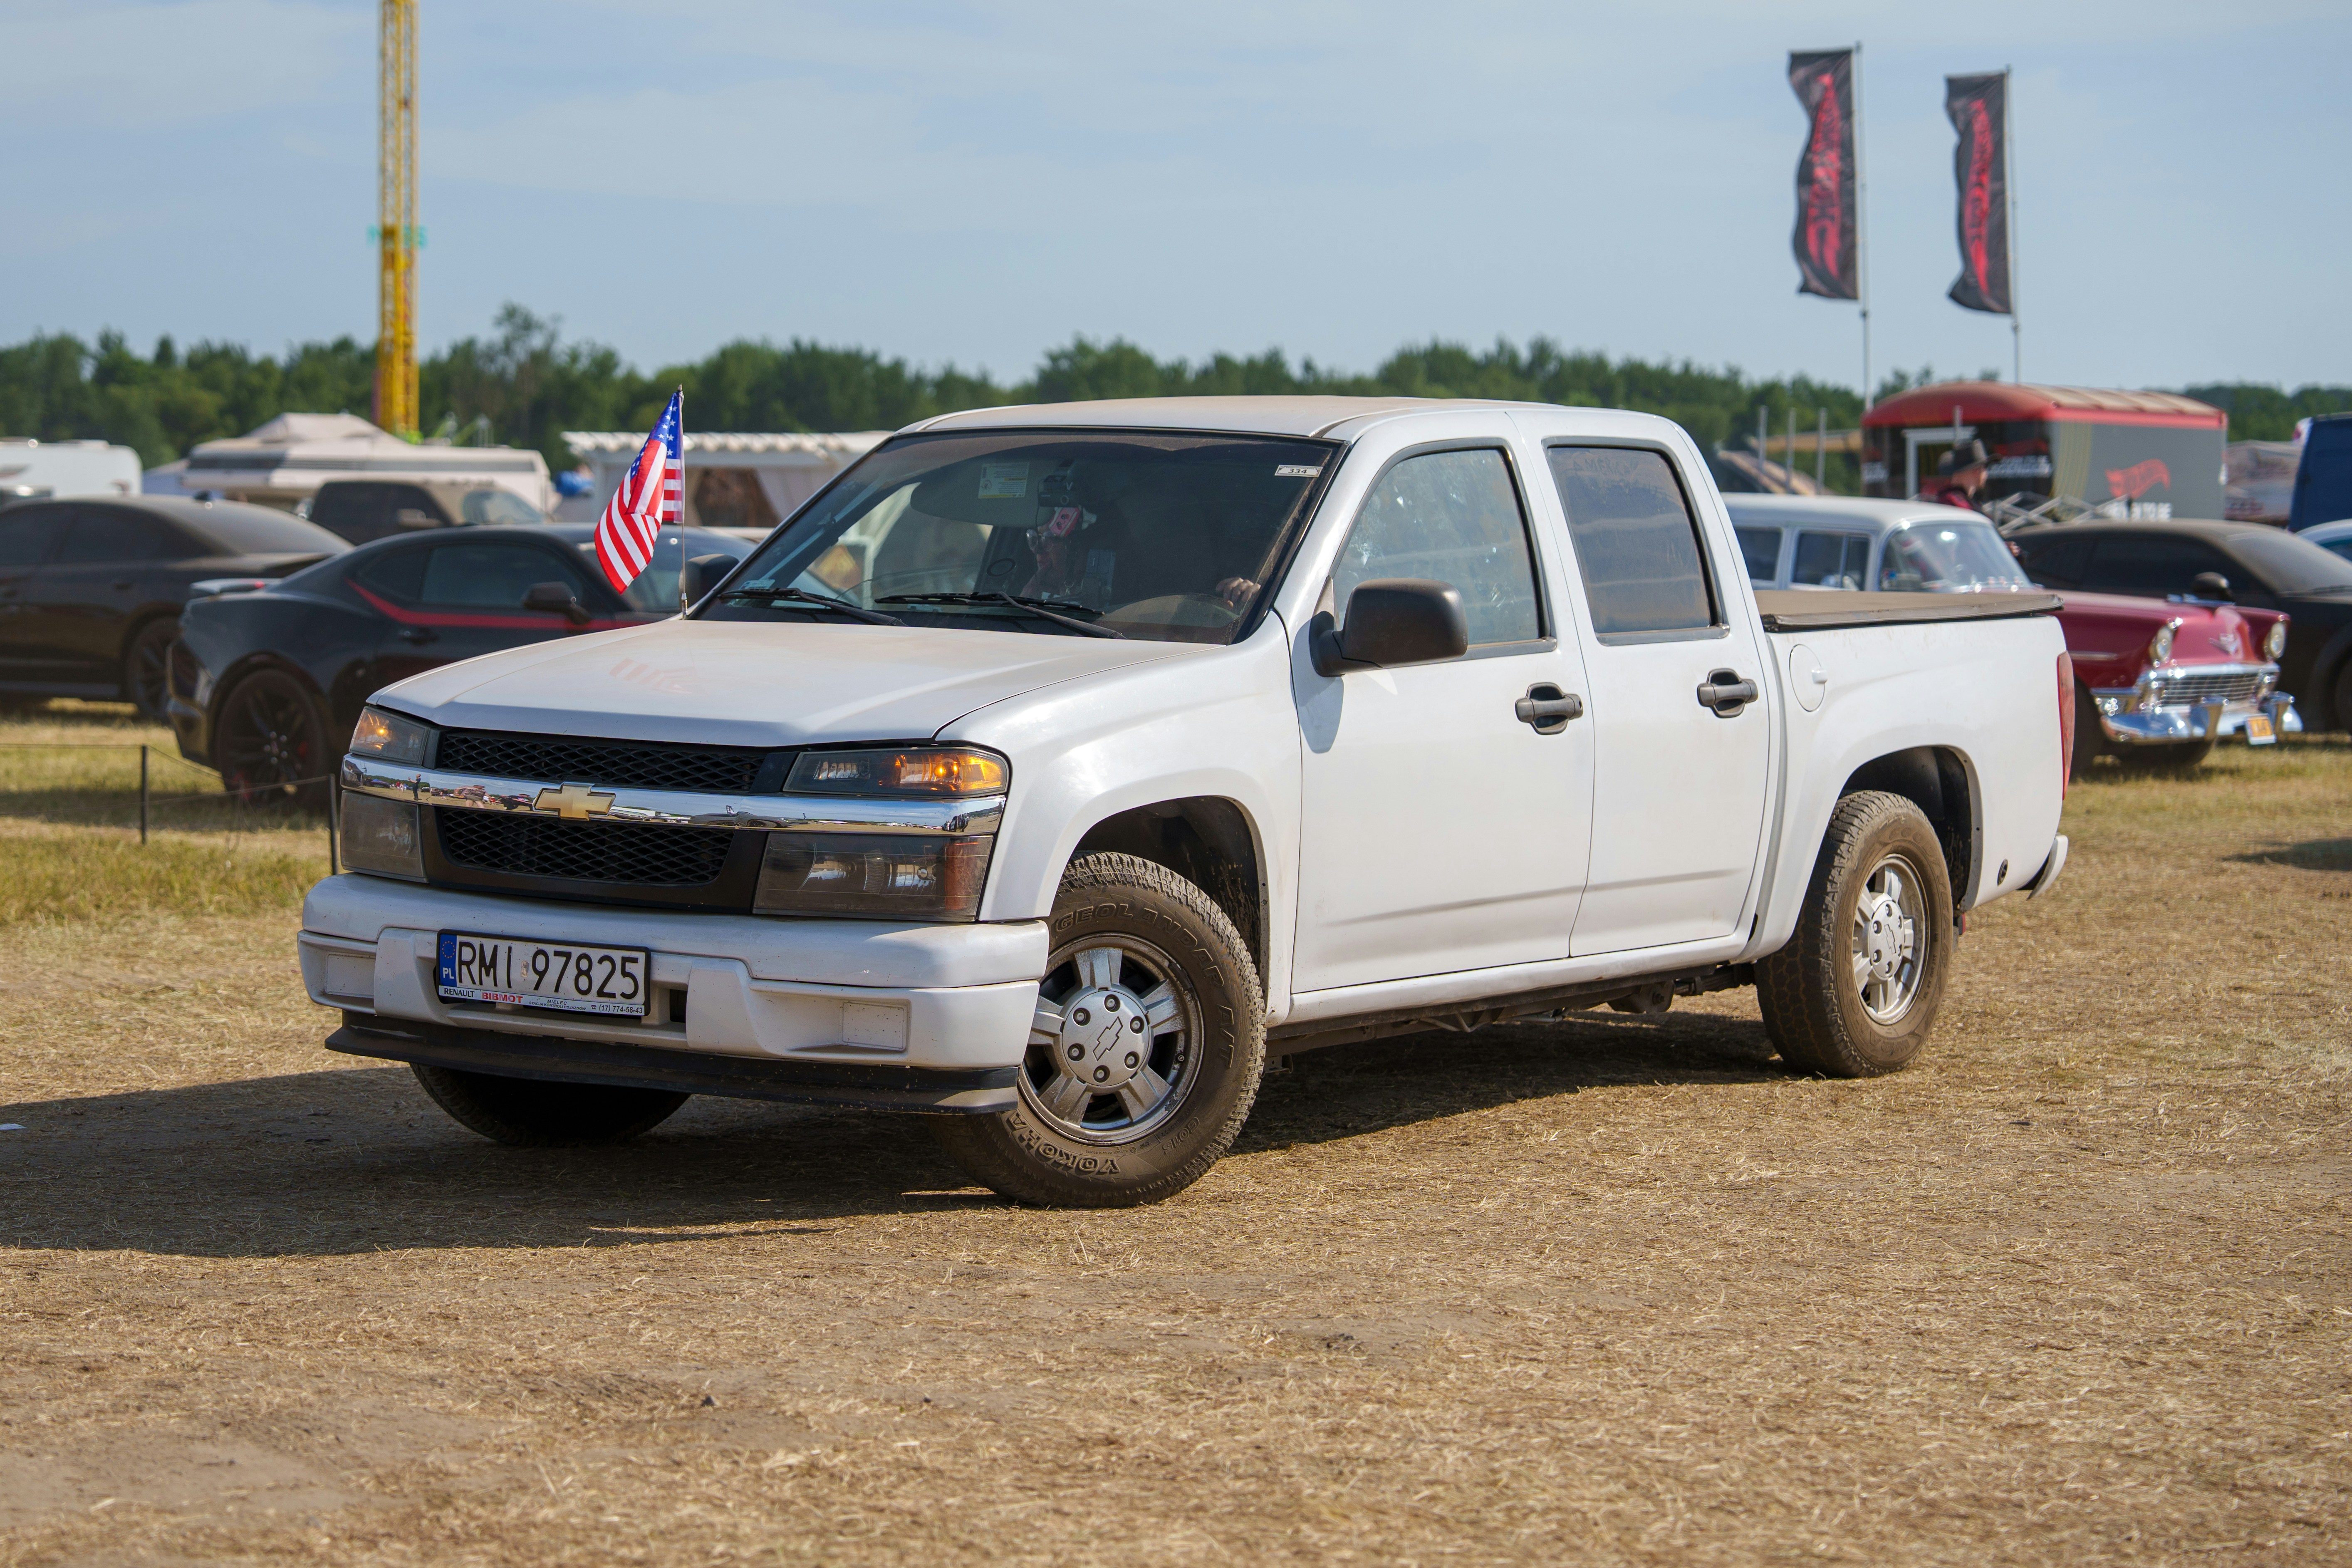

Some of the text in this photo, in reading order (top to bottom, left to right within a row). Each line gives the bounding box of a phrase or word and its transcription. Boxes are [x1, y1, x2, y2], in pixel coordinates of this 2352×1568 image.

[1055, 903, 1224, 987] GEOLANDAR
[443, 968, 454, 979] PL
[458, 941, 639, 999] RMI 97825
[444, 988, 523, 1003] RENAULT BIBMOT
[599, 1004, 643, 1014] (17) 774-58-43
[1216, 1003, 1235, 1068] A/T
[1009, 1109, 1121, 1172] YOKOHA
[1162, 1117, 1200, 1153] G015
